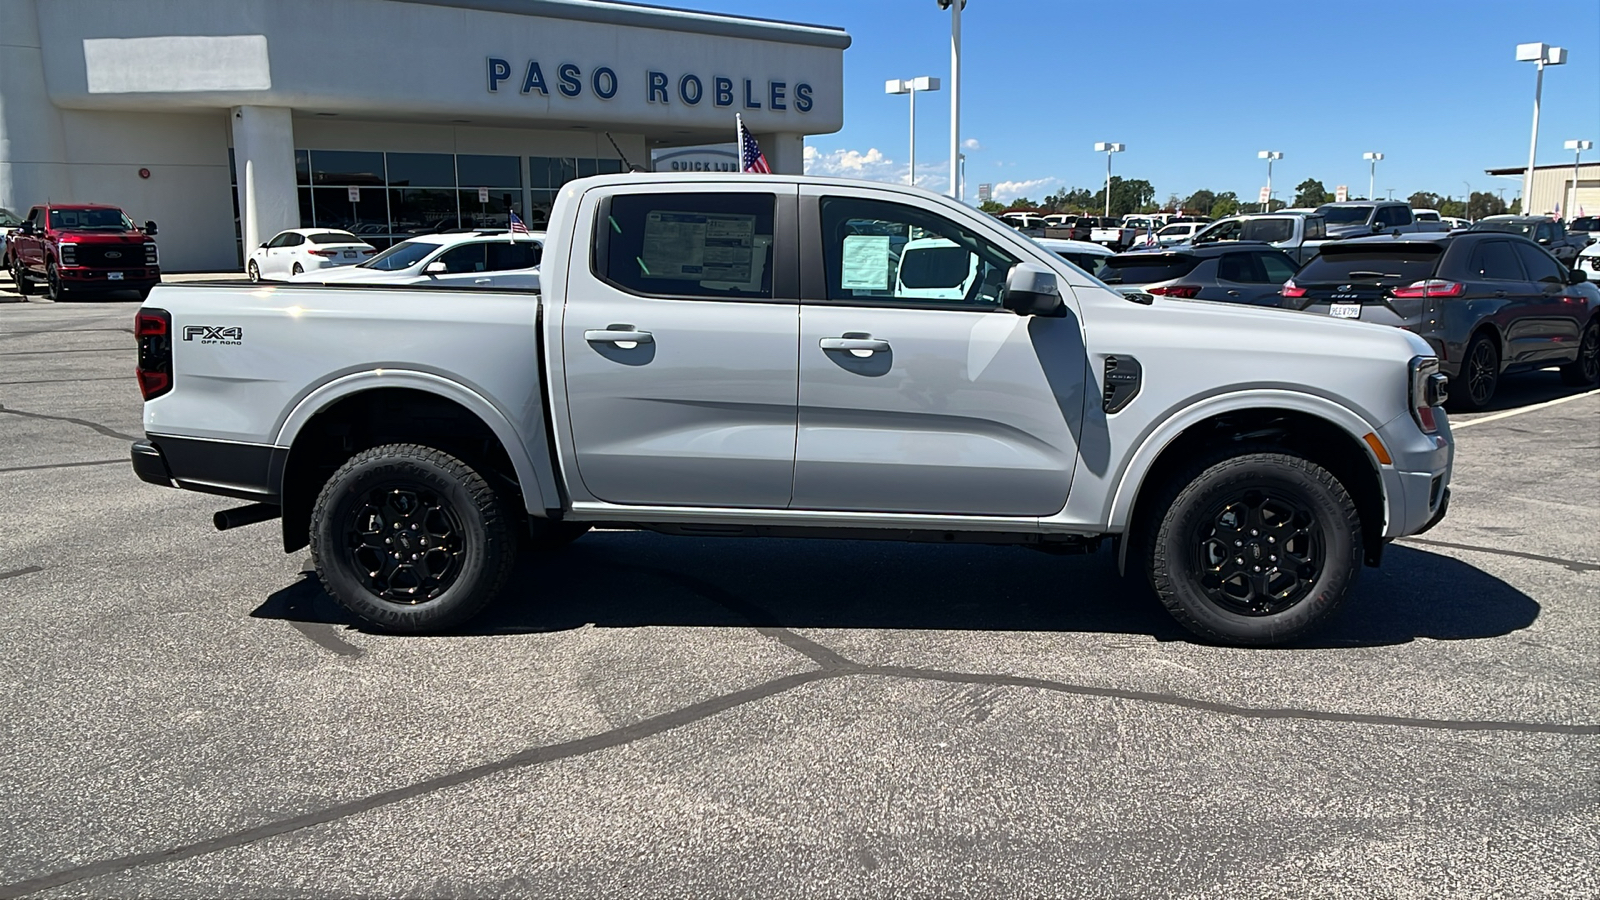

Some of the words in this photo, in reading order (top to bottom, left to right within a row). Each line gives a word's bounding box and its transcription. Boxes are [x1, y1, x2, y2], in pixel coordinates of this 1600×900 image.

[487, 57, 618, 100] PASO
[647, 70, 814, 113] ROBLES
[672, 161, 710, 171] QUICK
[715, 163, 737, 172] LUB
[183, 326, 242, 340] FX4
